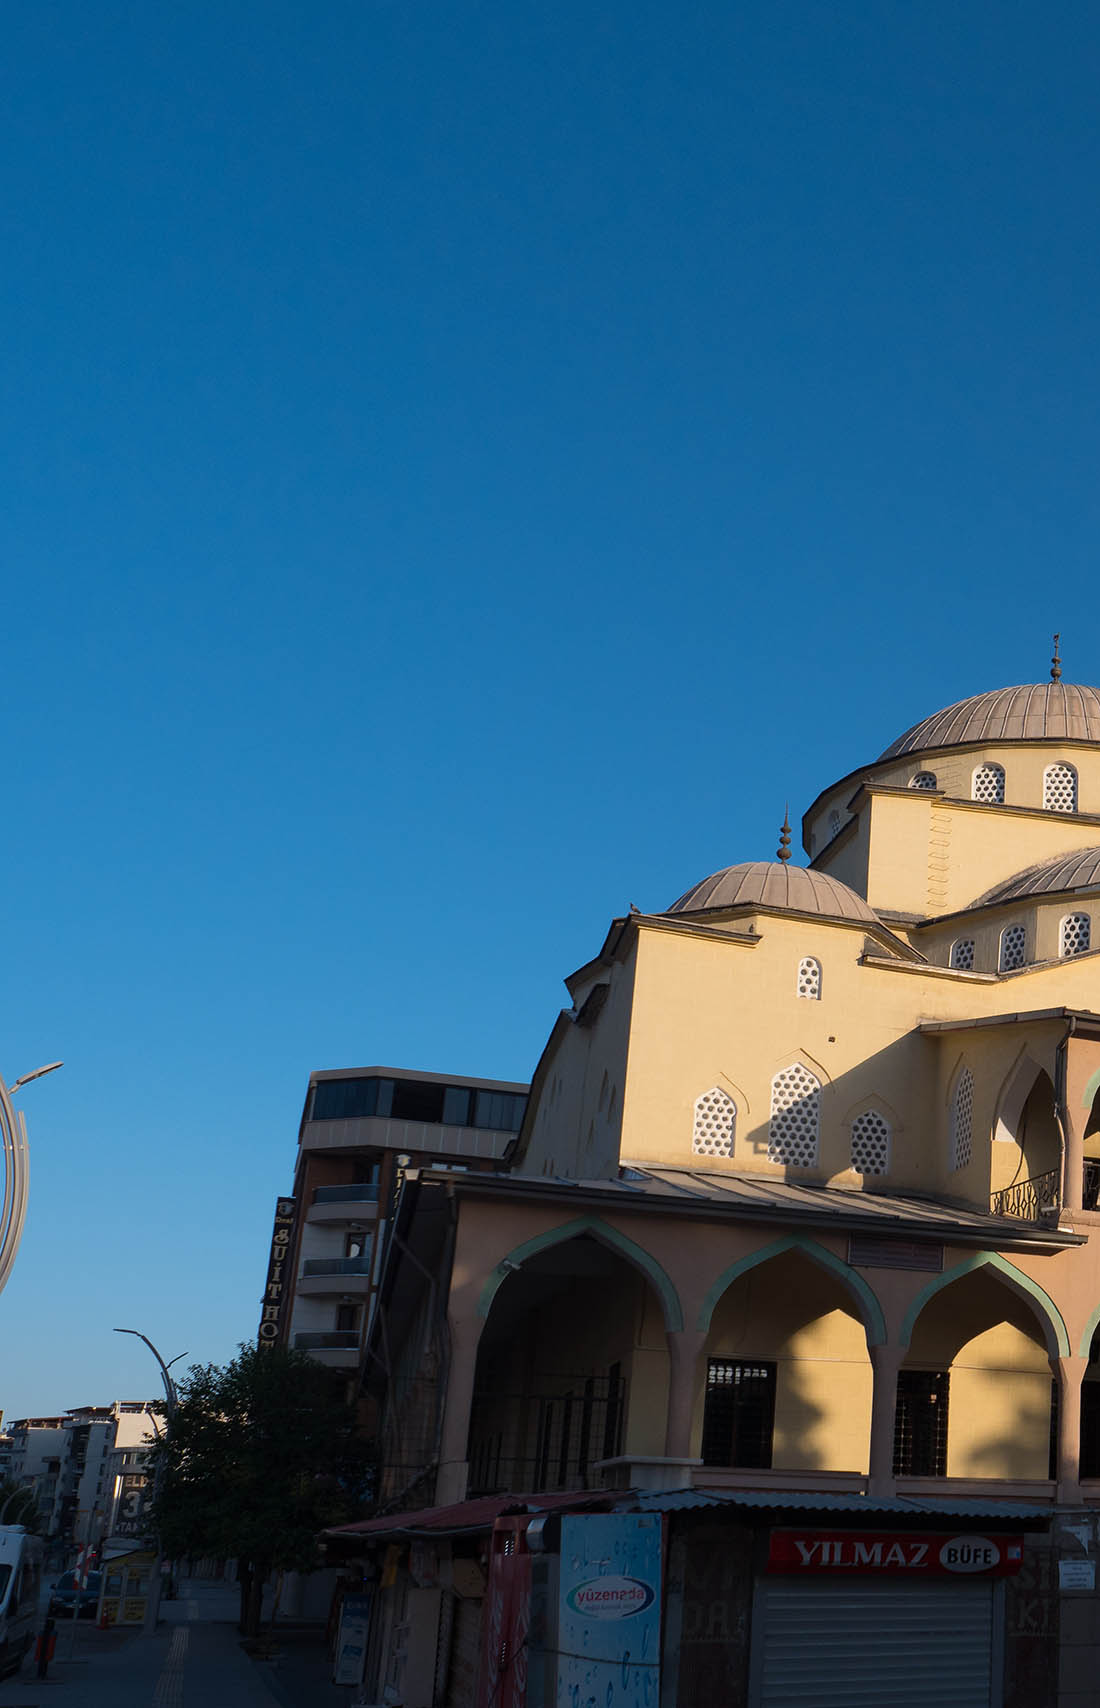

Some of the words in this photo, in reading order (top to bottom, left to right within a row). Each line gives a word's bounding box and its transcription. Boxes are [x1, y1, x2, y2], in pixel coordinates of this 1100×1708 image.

[793, 1540, 930, 1568] YILMAZ
[947, 1543, 992, 1564] BÜFE
[577, 1587, 645, 1605] yüzenada
